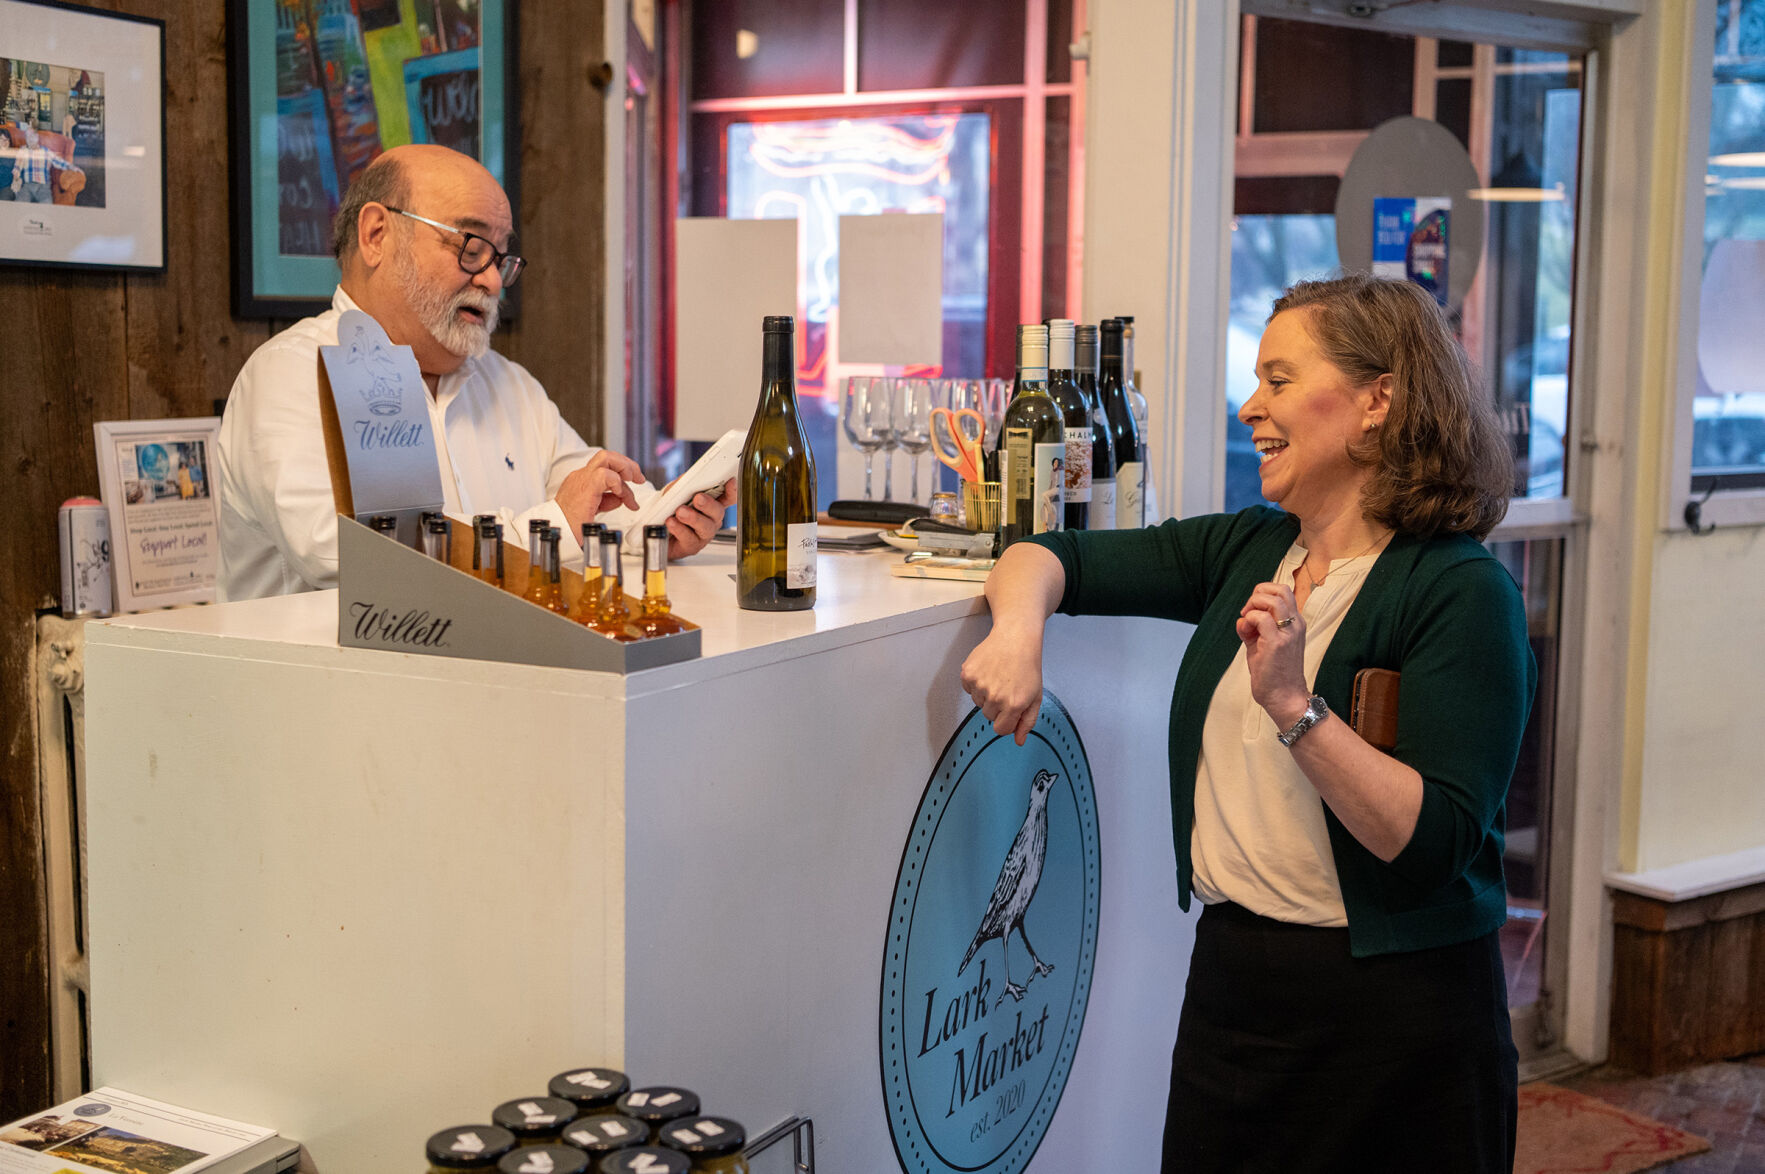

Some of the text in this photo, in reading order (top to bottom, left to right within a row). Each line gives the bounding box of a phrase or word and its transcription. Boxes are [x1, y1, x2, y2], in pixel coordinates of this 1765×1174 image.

[353, 420, 424, 450] Willett
[140, 535, 177, 557] Support
[349, 601, 451, 647] Willett
[917, 958, 991, 1058] Lark
[945, 1003, 1049, 1119] Market
[970, 1079, 1026, 1143] est. 2020
